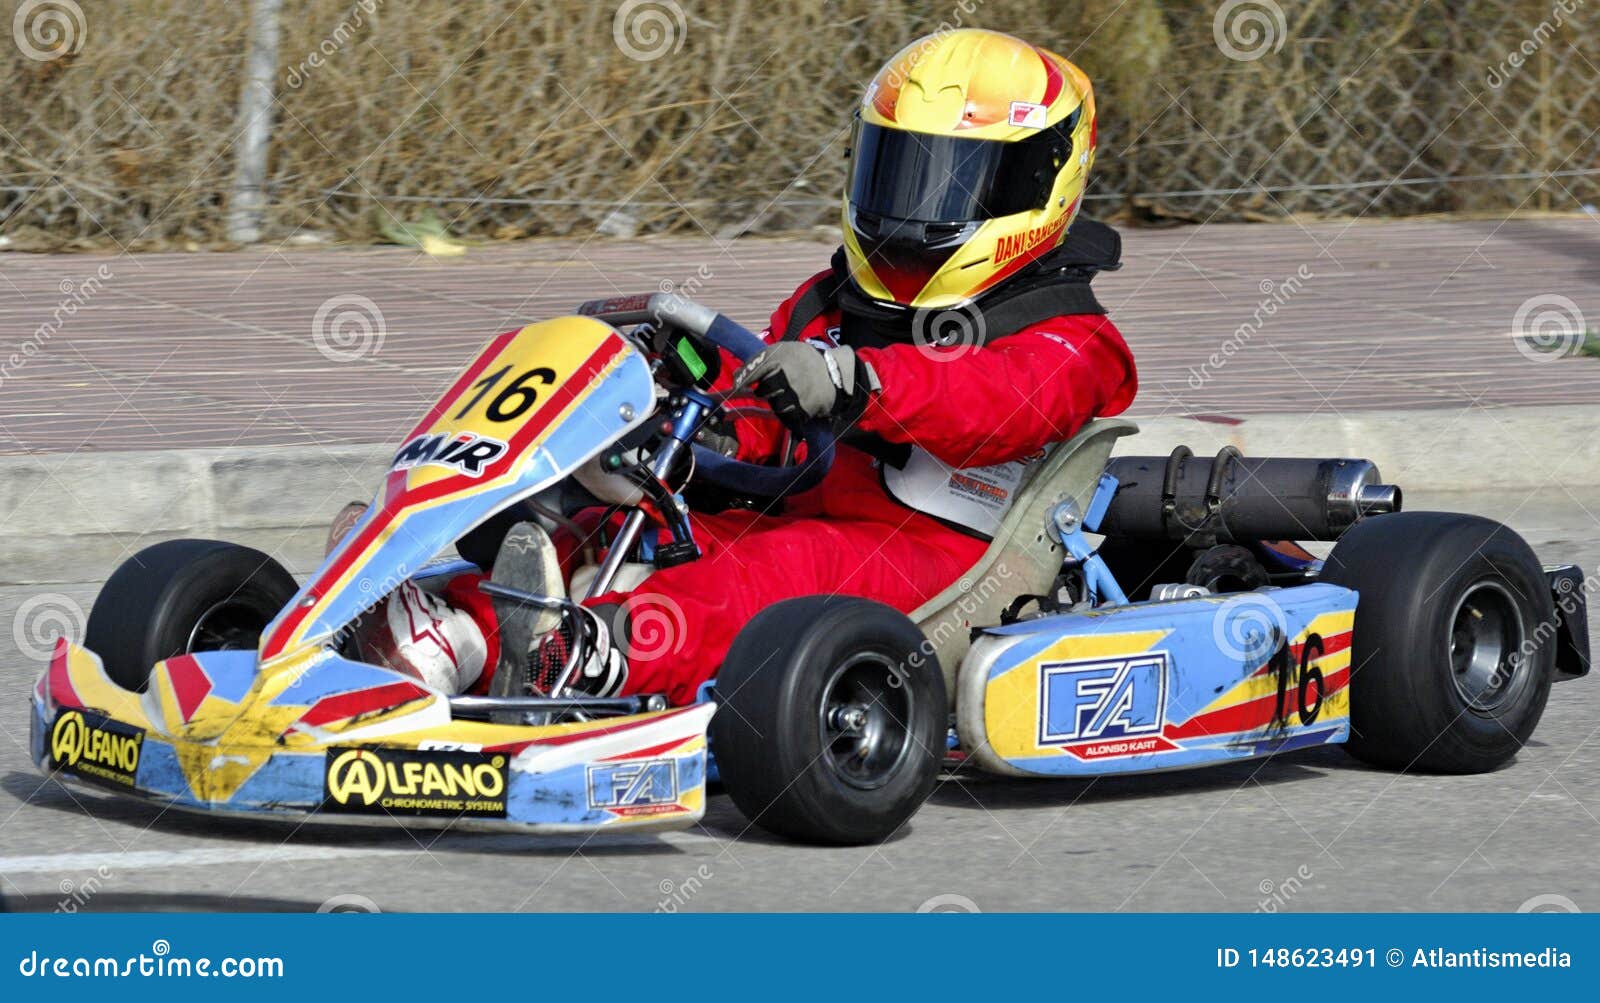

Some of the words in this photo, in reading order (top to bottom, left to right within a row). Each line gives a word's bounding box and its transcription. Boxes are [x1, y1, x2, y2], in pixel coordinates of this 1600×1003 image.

[993, 231, 1027, 265] DANI
[453, 364, 557, 423] 16
[1042, 660, 1163, 741] FA
[1268, 632, 1324, 732] 16
[52, 711, 138, 772] ALFANO
[1086, 743, 1128, 756] ALONSO
[1129, 740, 1157, 751] KART
[328, 750, 504, 806] ALFANO
[382, 799, 463, 811] CHRONOMETRIC
[465, 801, 503, 812] SYSTEM
[590, 764, 674, 805] FA
